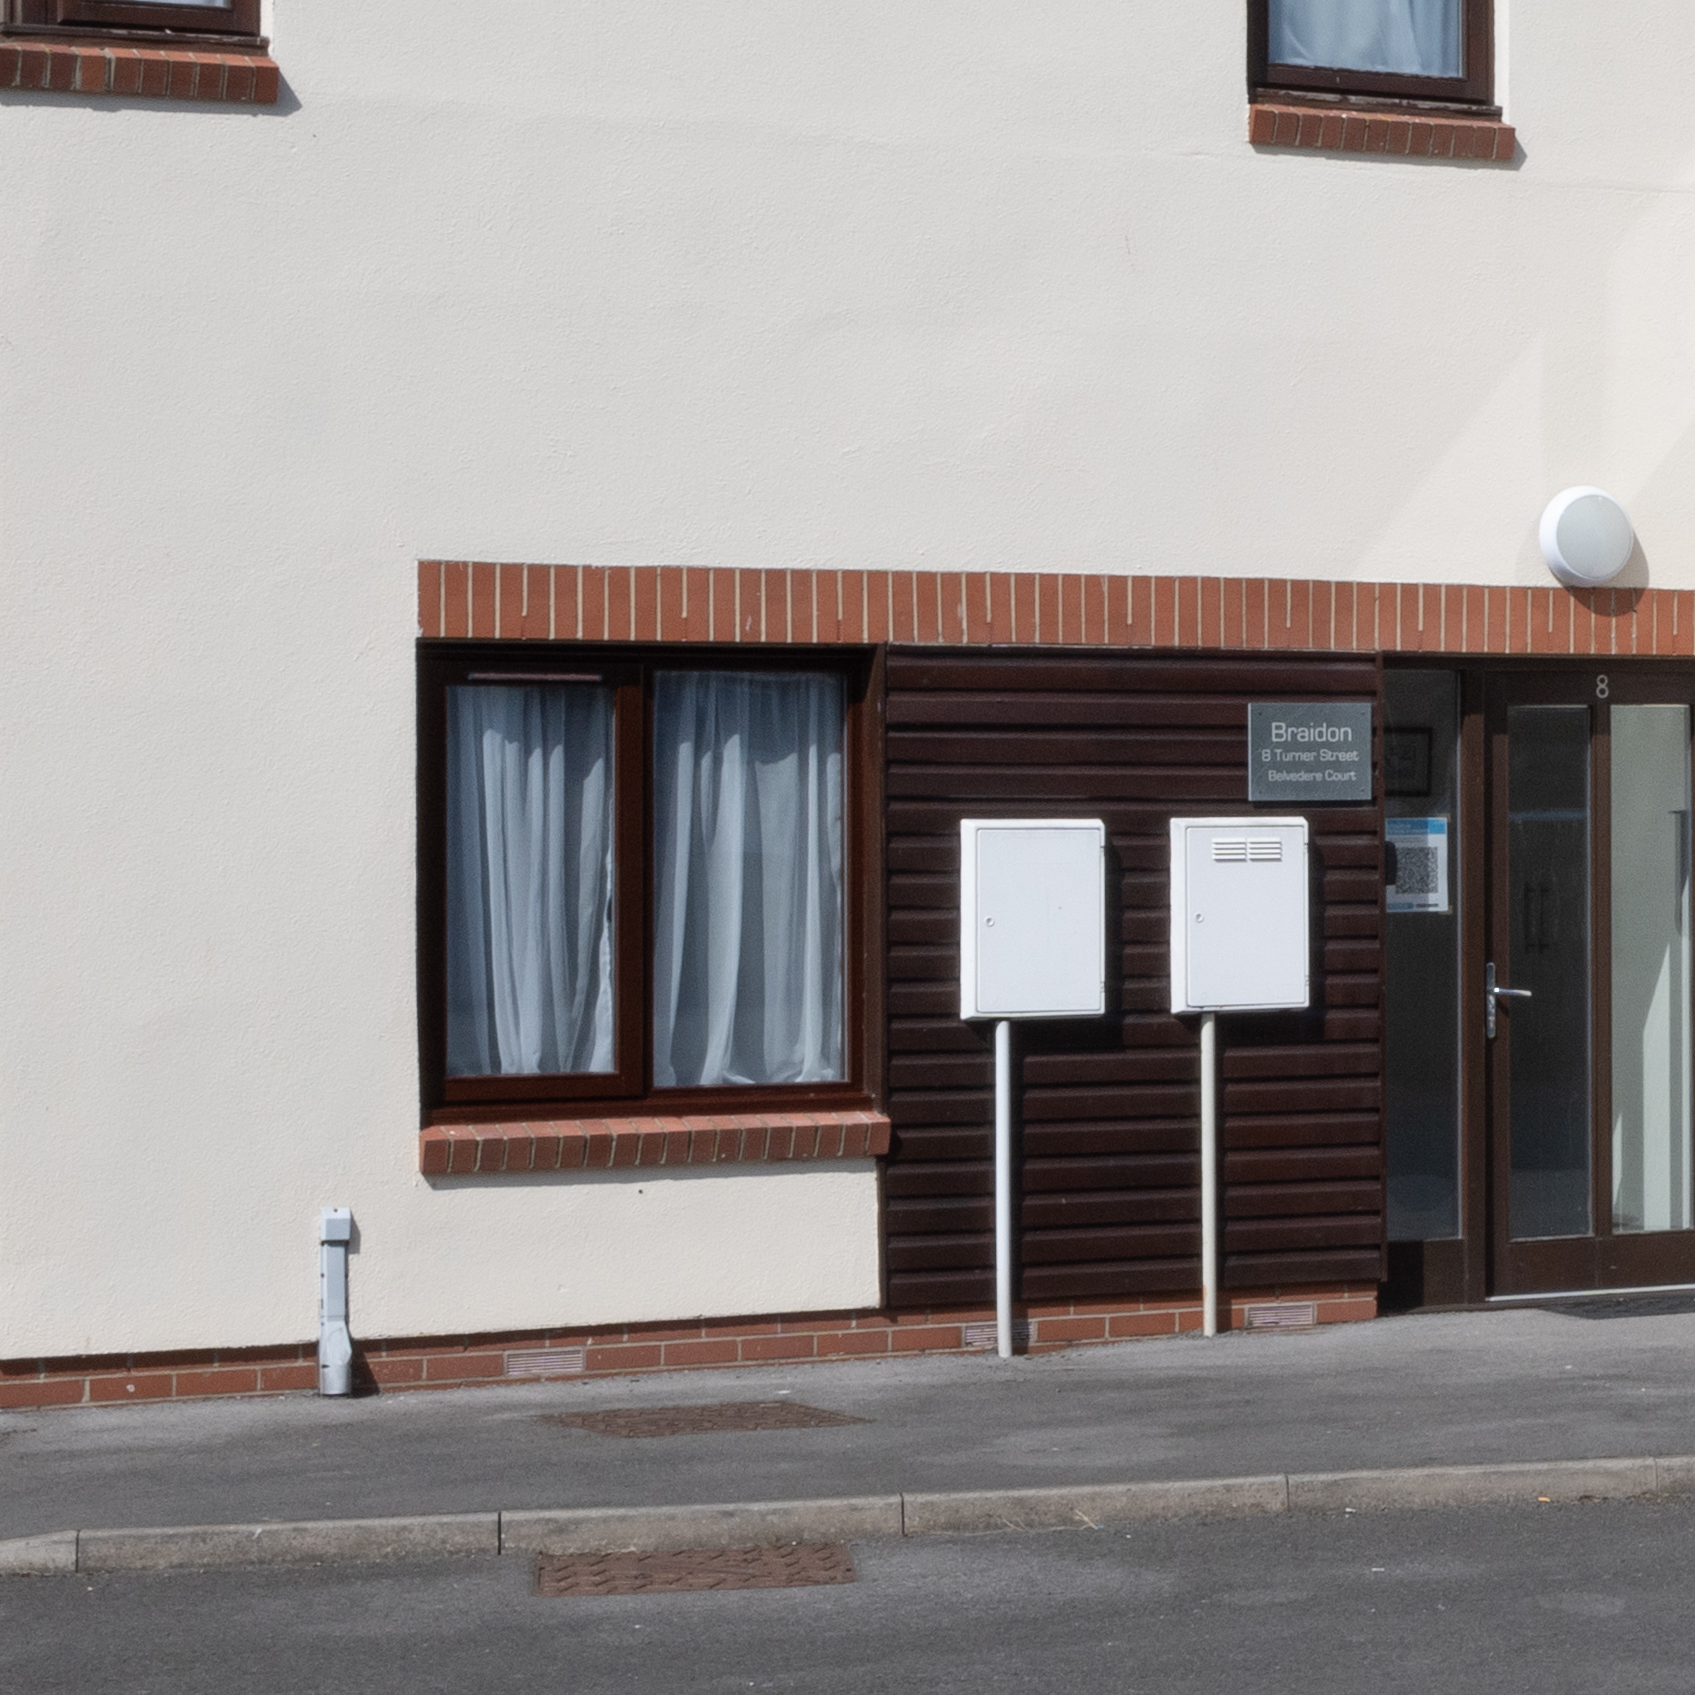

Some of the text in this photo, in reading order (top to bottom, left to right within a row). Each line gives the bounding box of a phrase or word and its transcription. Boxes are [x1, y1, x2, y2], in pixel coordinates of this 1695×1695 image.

[1596, 674, 1609, 699] 8
[1271, 722, 1352, 742] Braidon
[1261, 749, 1360, 762] 8 Turner Street
[1268, 769, 1357, 782] Belvedere Court
